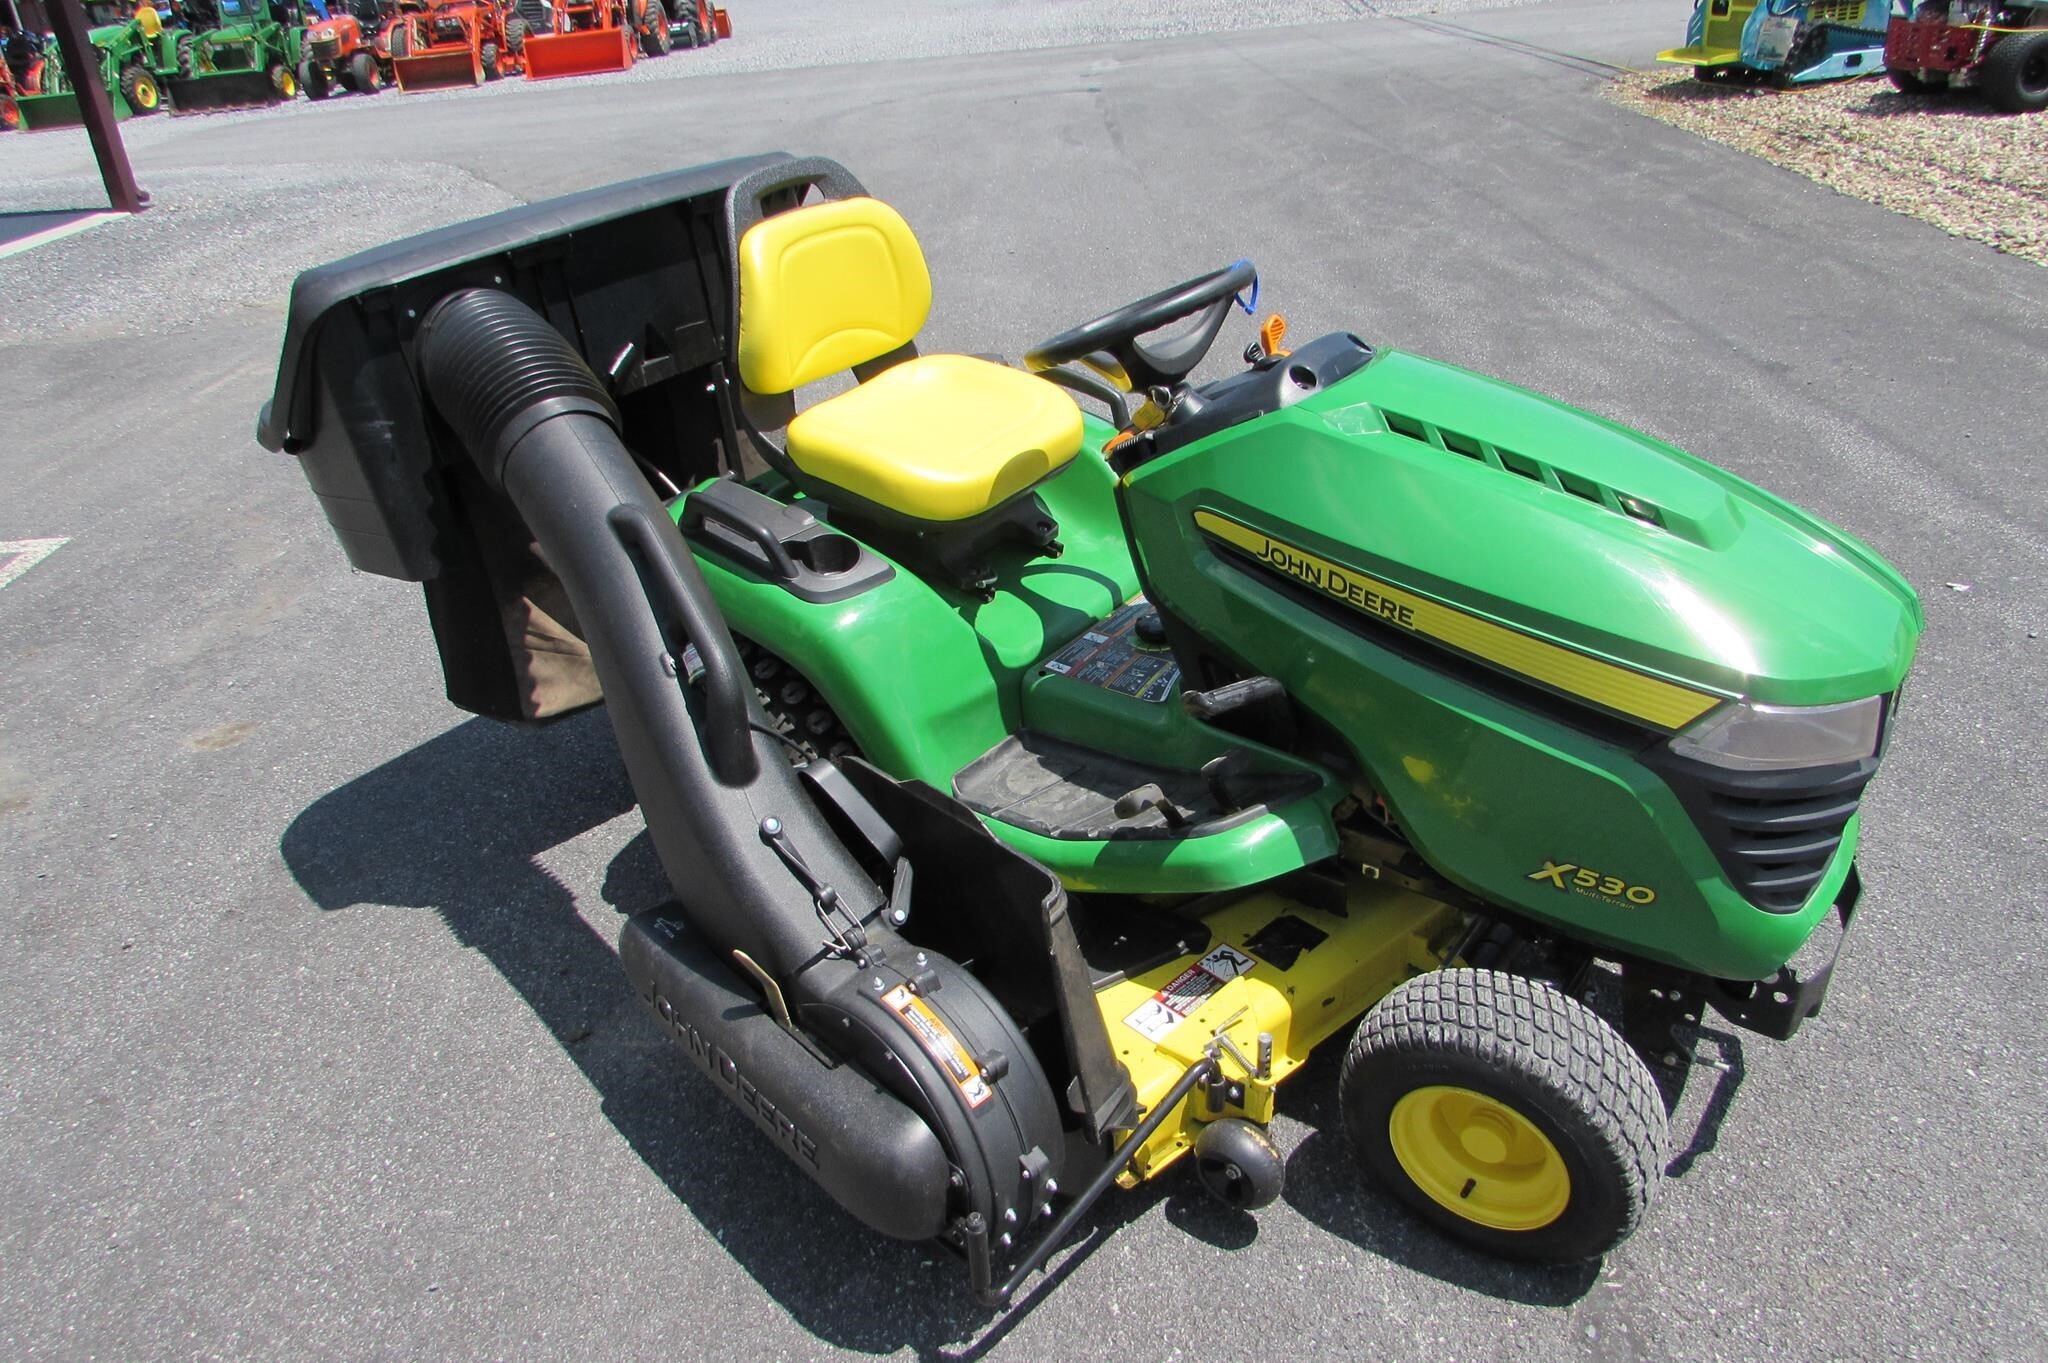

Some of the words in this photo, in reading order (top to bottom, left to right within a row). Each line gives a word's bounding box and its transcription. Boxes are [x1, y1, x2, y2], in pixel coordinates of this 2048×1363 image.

[1256, 540, 1322, 585] JOHN
[1328, 569, 1415, 627] DEERE
[1527, 861, 1656, 904] X530
[1166, 969, 1196, 991] DANGER
[643, 979, 714, 1069] JOHN
[717, 1047, 821, 1171] DEERE
